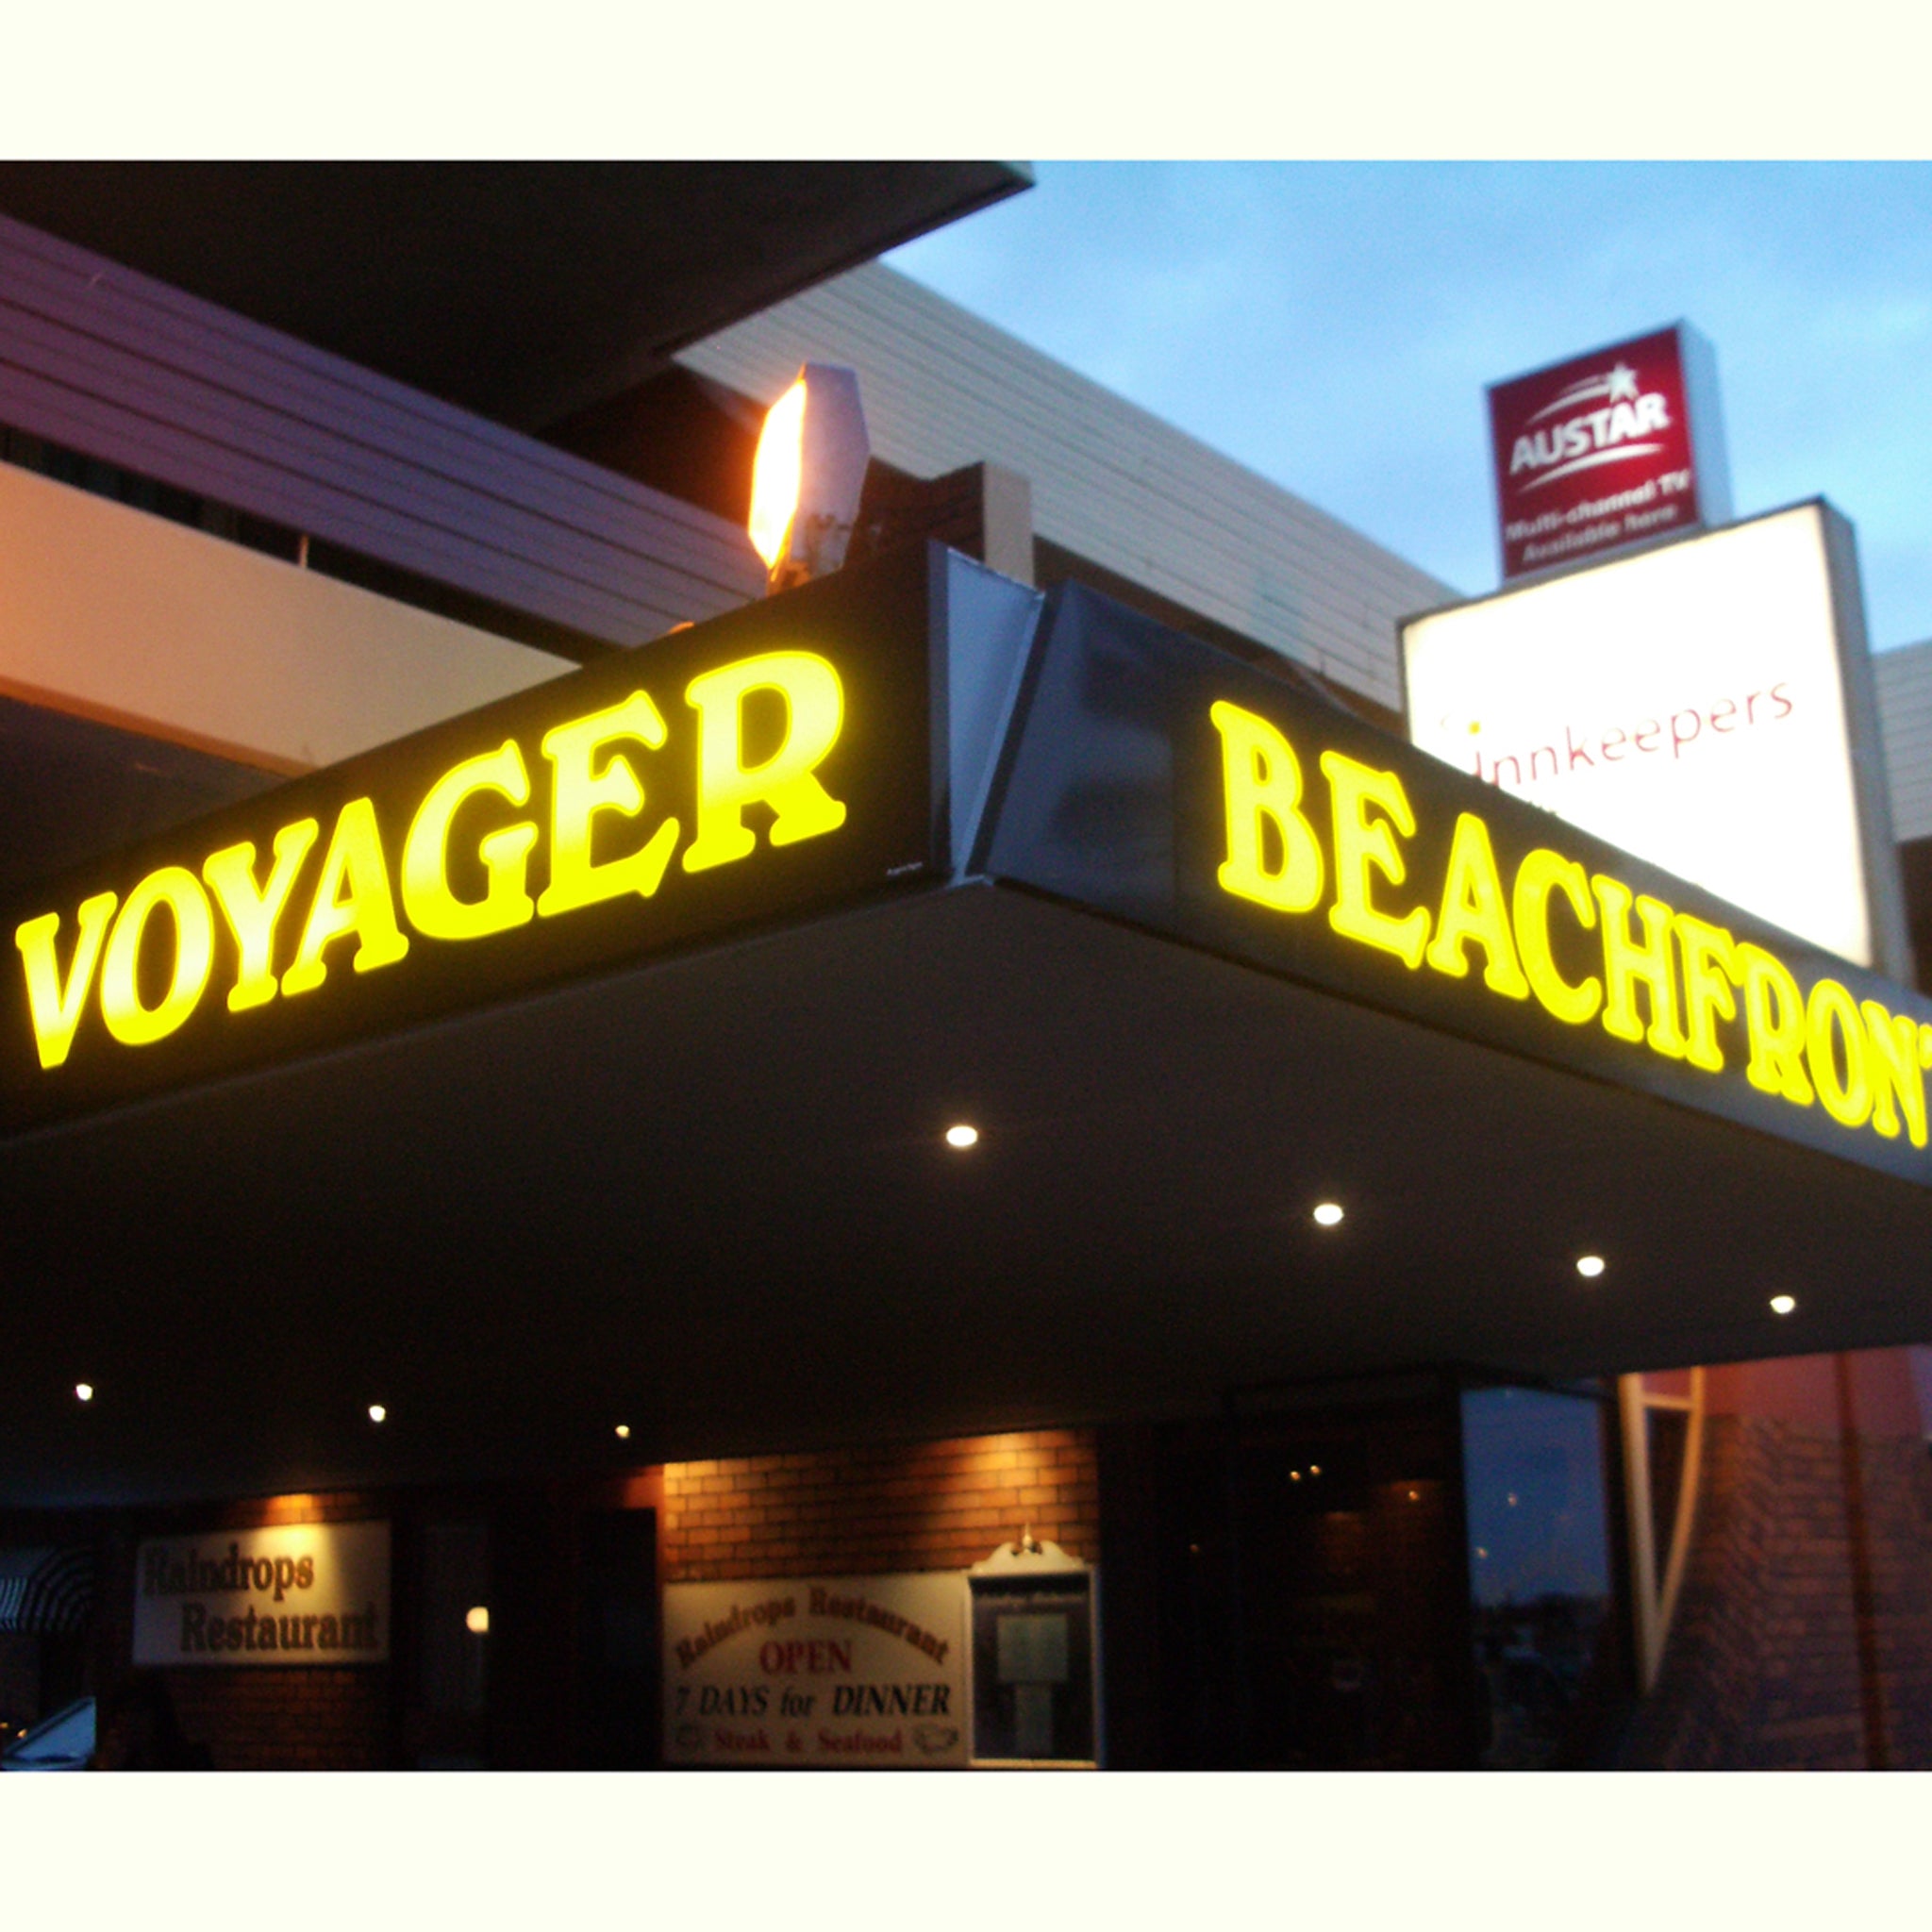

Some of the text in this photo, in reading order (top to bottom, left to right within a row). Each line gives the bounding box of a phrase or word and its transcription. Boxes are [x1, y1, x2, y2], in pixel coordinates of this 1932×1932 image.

[1510, 392, 1671, 475] AUSTAR
[1656, 468, 1690, 495] TV
[15, 651, 846, 1069] VOYAGER
[142, 1541, 314, 1602] Raindrops
[180, 1601, 377, 1652] Restaurant
[675, 1587, 948, 1669] Raindrops Restaurant
[759, 1640, 853, 1674] OPEN
[676, 1683, 951, 1717] 7 DAYS for DINNER
[714, 1728, 903, 1753] Steak & Seafood
